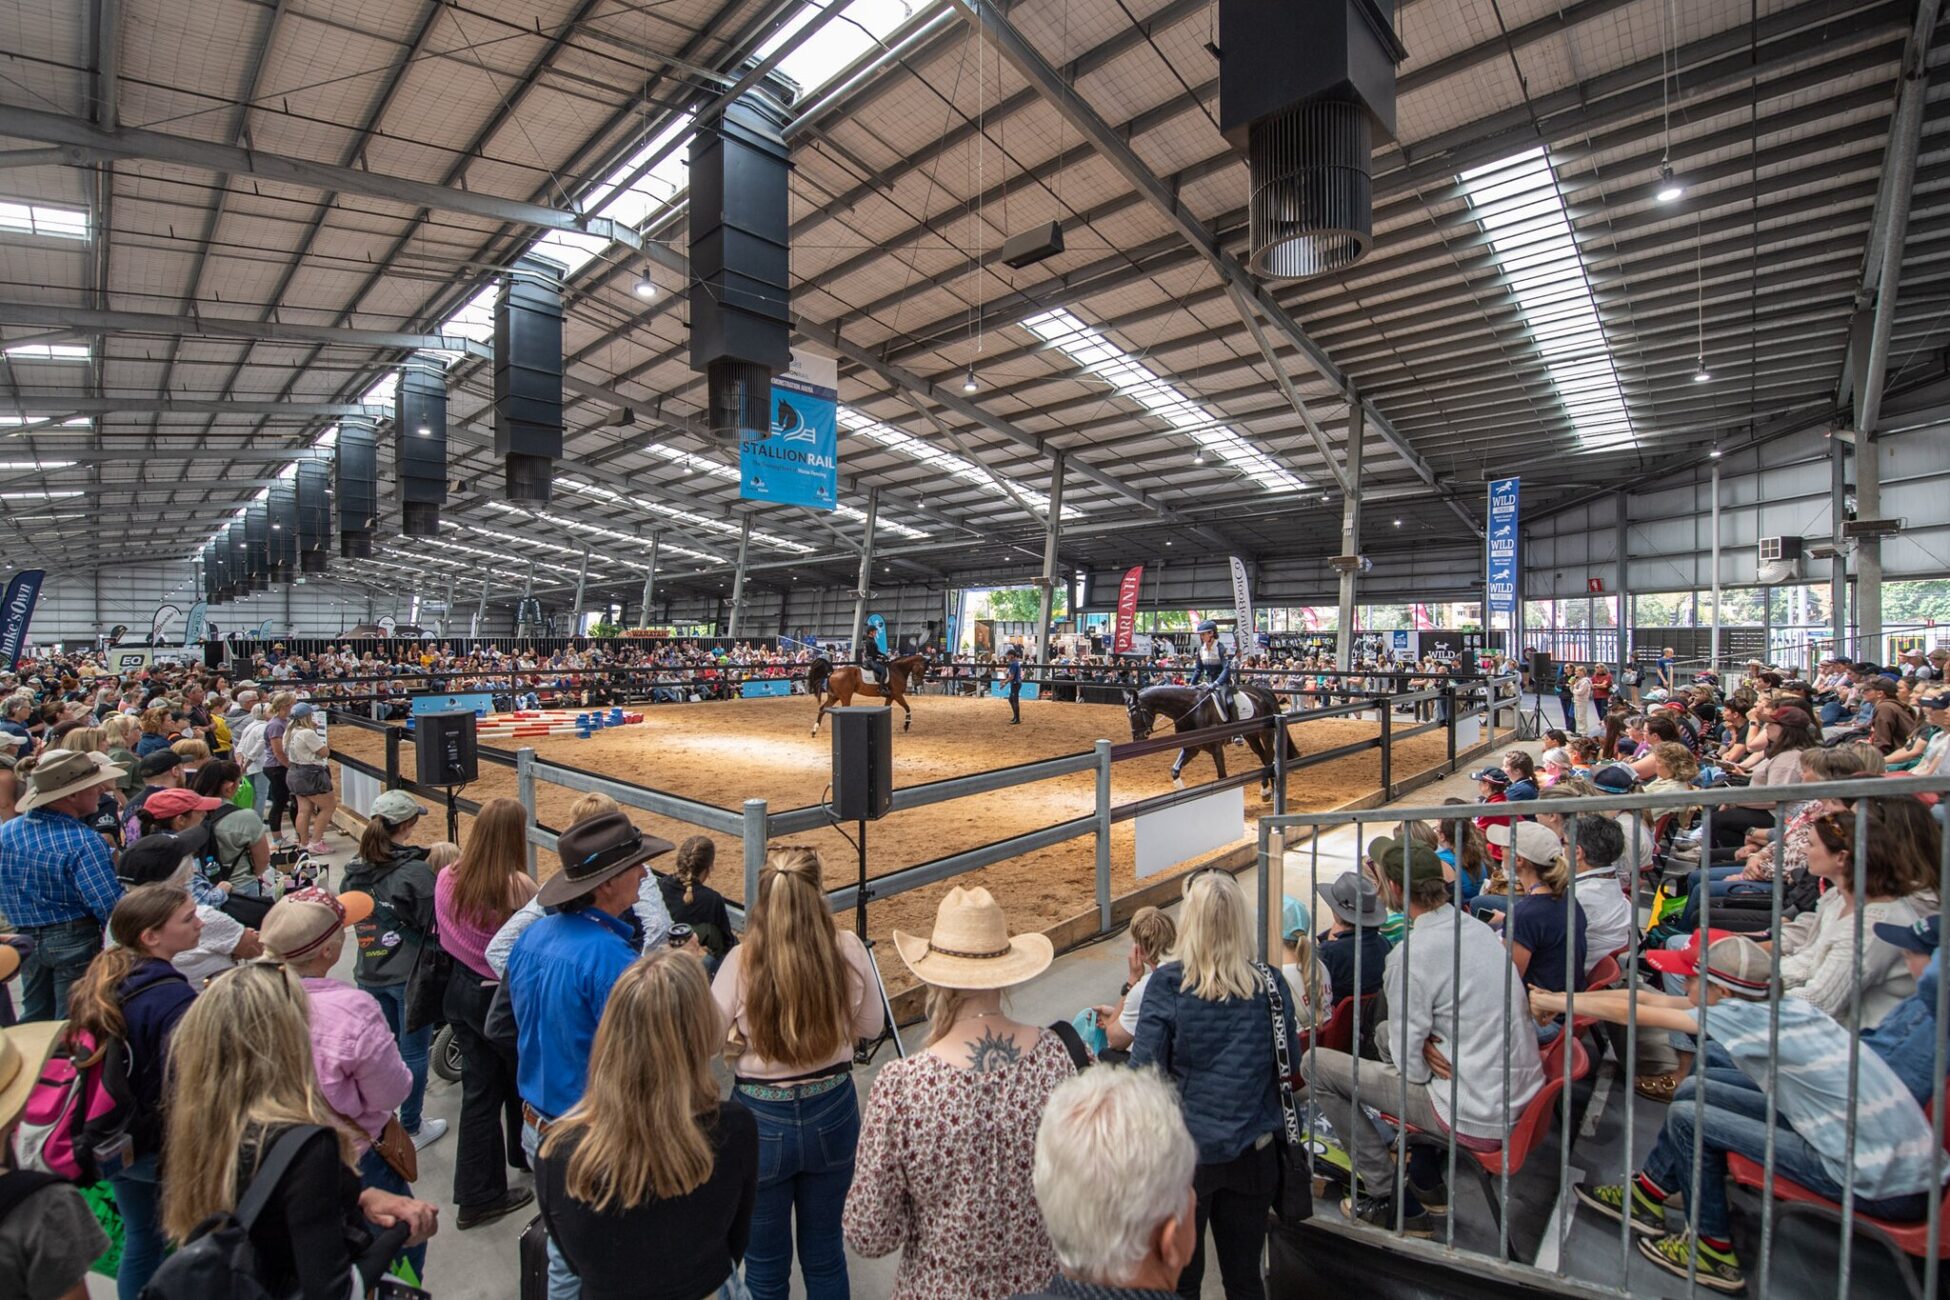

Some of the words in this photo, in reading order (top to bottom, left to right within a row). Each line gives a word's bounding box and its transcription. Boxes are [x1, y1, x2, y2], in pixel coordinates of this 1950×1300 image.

[743, 441, 835, 469] STALLIONRAIL
[1492, 494, 1516, 507] WILD
[1490, 539, 1514, 550] WILD
[1490, 583, 1514, 593] WILD
[1118, 577, 1137, 648] PARLANTI
[121, 656, 142, 665] EQ
[1428, 651, 1456, 659] WILD
[1257, 962, 1276, 992] DKN
[1274, 1012, 1286, 1049] DKN
